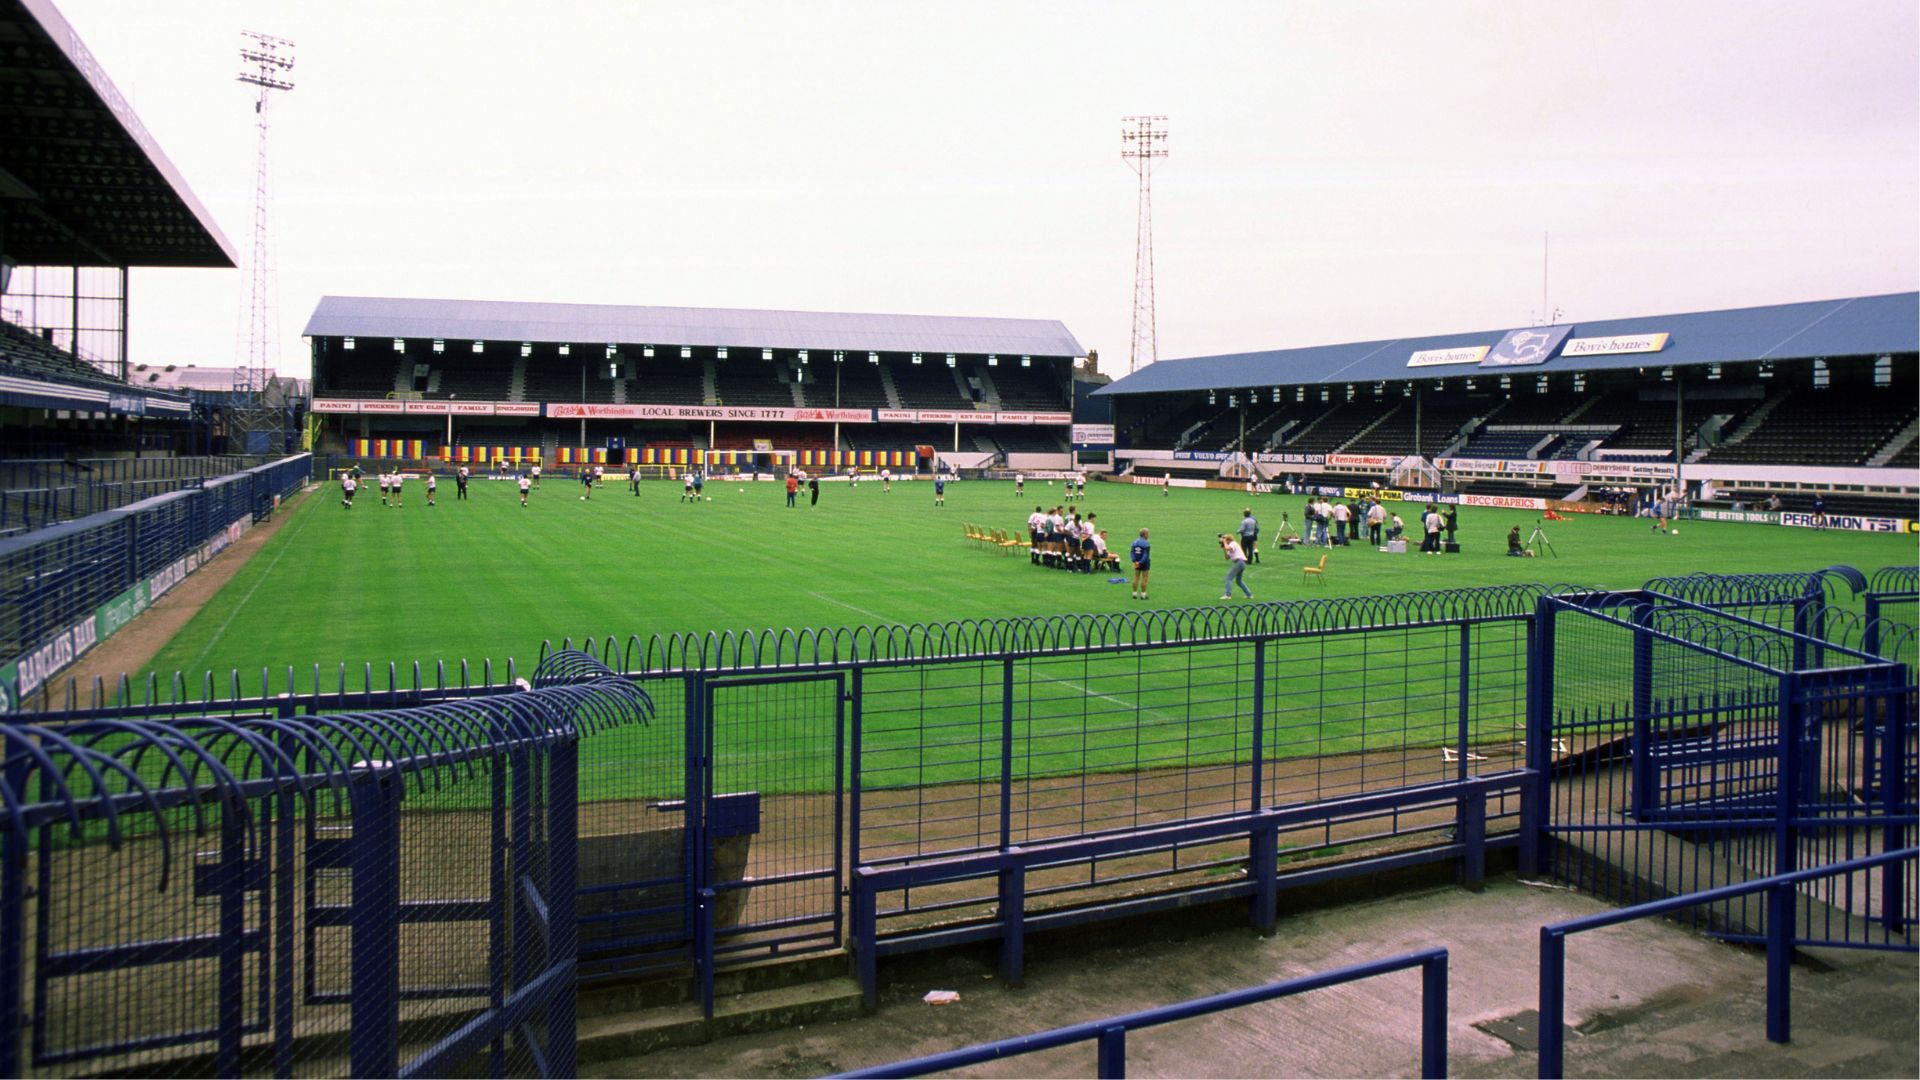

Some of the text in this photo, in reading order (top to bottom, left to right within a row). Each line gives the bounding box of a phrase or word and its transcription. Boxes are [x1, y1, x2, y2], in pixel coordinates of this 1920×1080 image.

[1609, 339, 1651, 350] homes
[642, 408, 674, 416] LOCAL
[678, 408, 723, 417] BREWERS
[728, 409, 756, 418] SINCE
[760, 410, 784, 418] 1777
[1305, 454, 1324, 463] SOCIETY
[1593, 464, 1630, 472] DERBYSHIRE
[1632, 466, 1653, 474] Getting
[1404, 493, 1459, 504] Girobank Loans
[1466, 496, 1534, 508] BPCC GRAPHICS
[1718, 512, 1744, 521] BETTER
[1746, 513, 1768, 522] TOOLS
